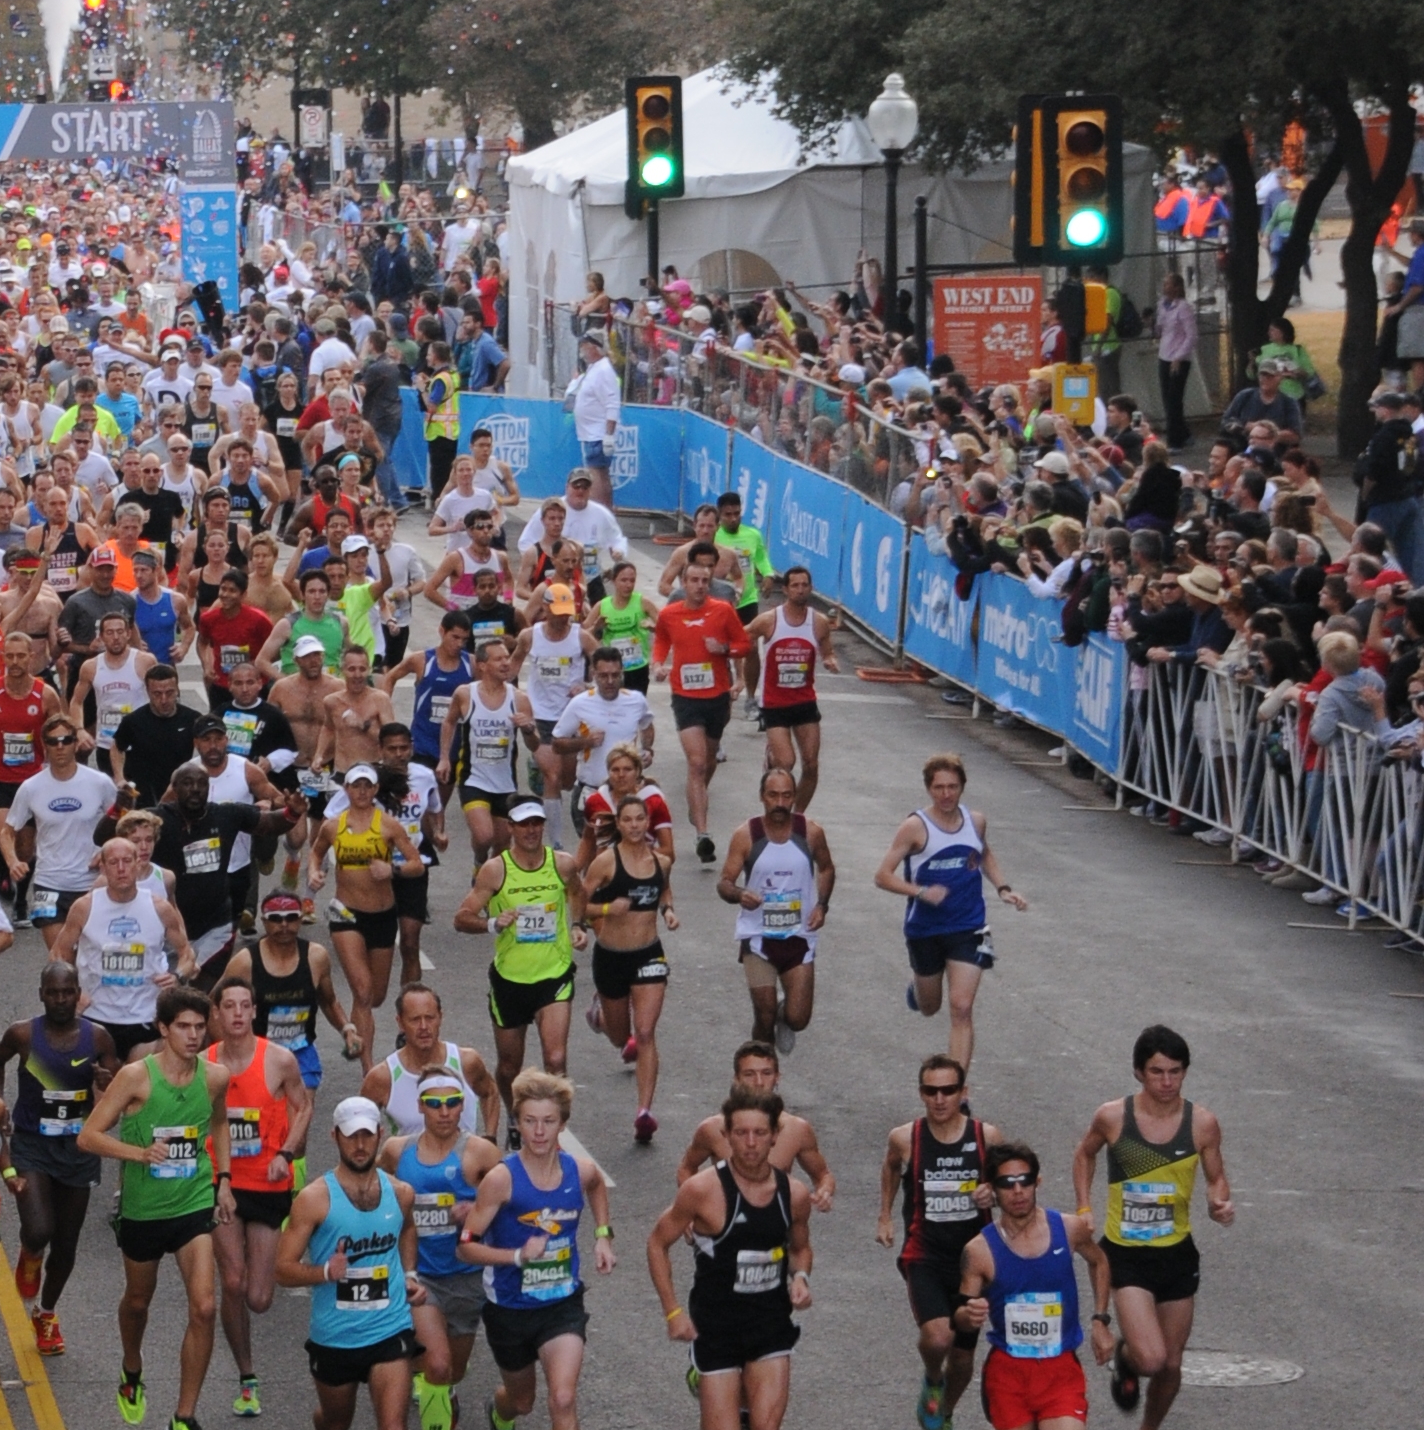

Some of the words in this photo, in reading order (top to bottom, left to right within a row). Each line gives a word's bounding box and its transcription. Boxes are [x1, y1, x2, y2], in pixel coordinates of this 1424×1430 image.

[51, 109, 146, 153] START
[943, 286, 993, 305] WEST
[997, 286, 1035, 305] END
[944, 305, 987, 314] HISTORIC
[989, 304, 1031, 314] DISTRICT
[493, 448, 527, 468] ATCH
[789, 500, 831, 559] BAYLOR
[983, 603, 1060, 672] metroPCS
[476, 719, 507, 728] TEAM
[508, 883, 559, 895] BROOKS
[524, 917, 545, 929] 212
[57, 1104, 67, 1119] 5
[937, 1156, 963, 1167] new
[924, 1168, 979, 1180] balance
[925, 1196, 970, 1212] 20049
[340, 1231, 398, 1253] Parker
[351, 1284, 370, 1301] 12
